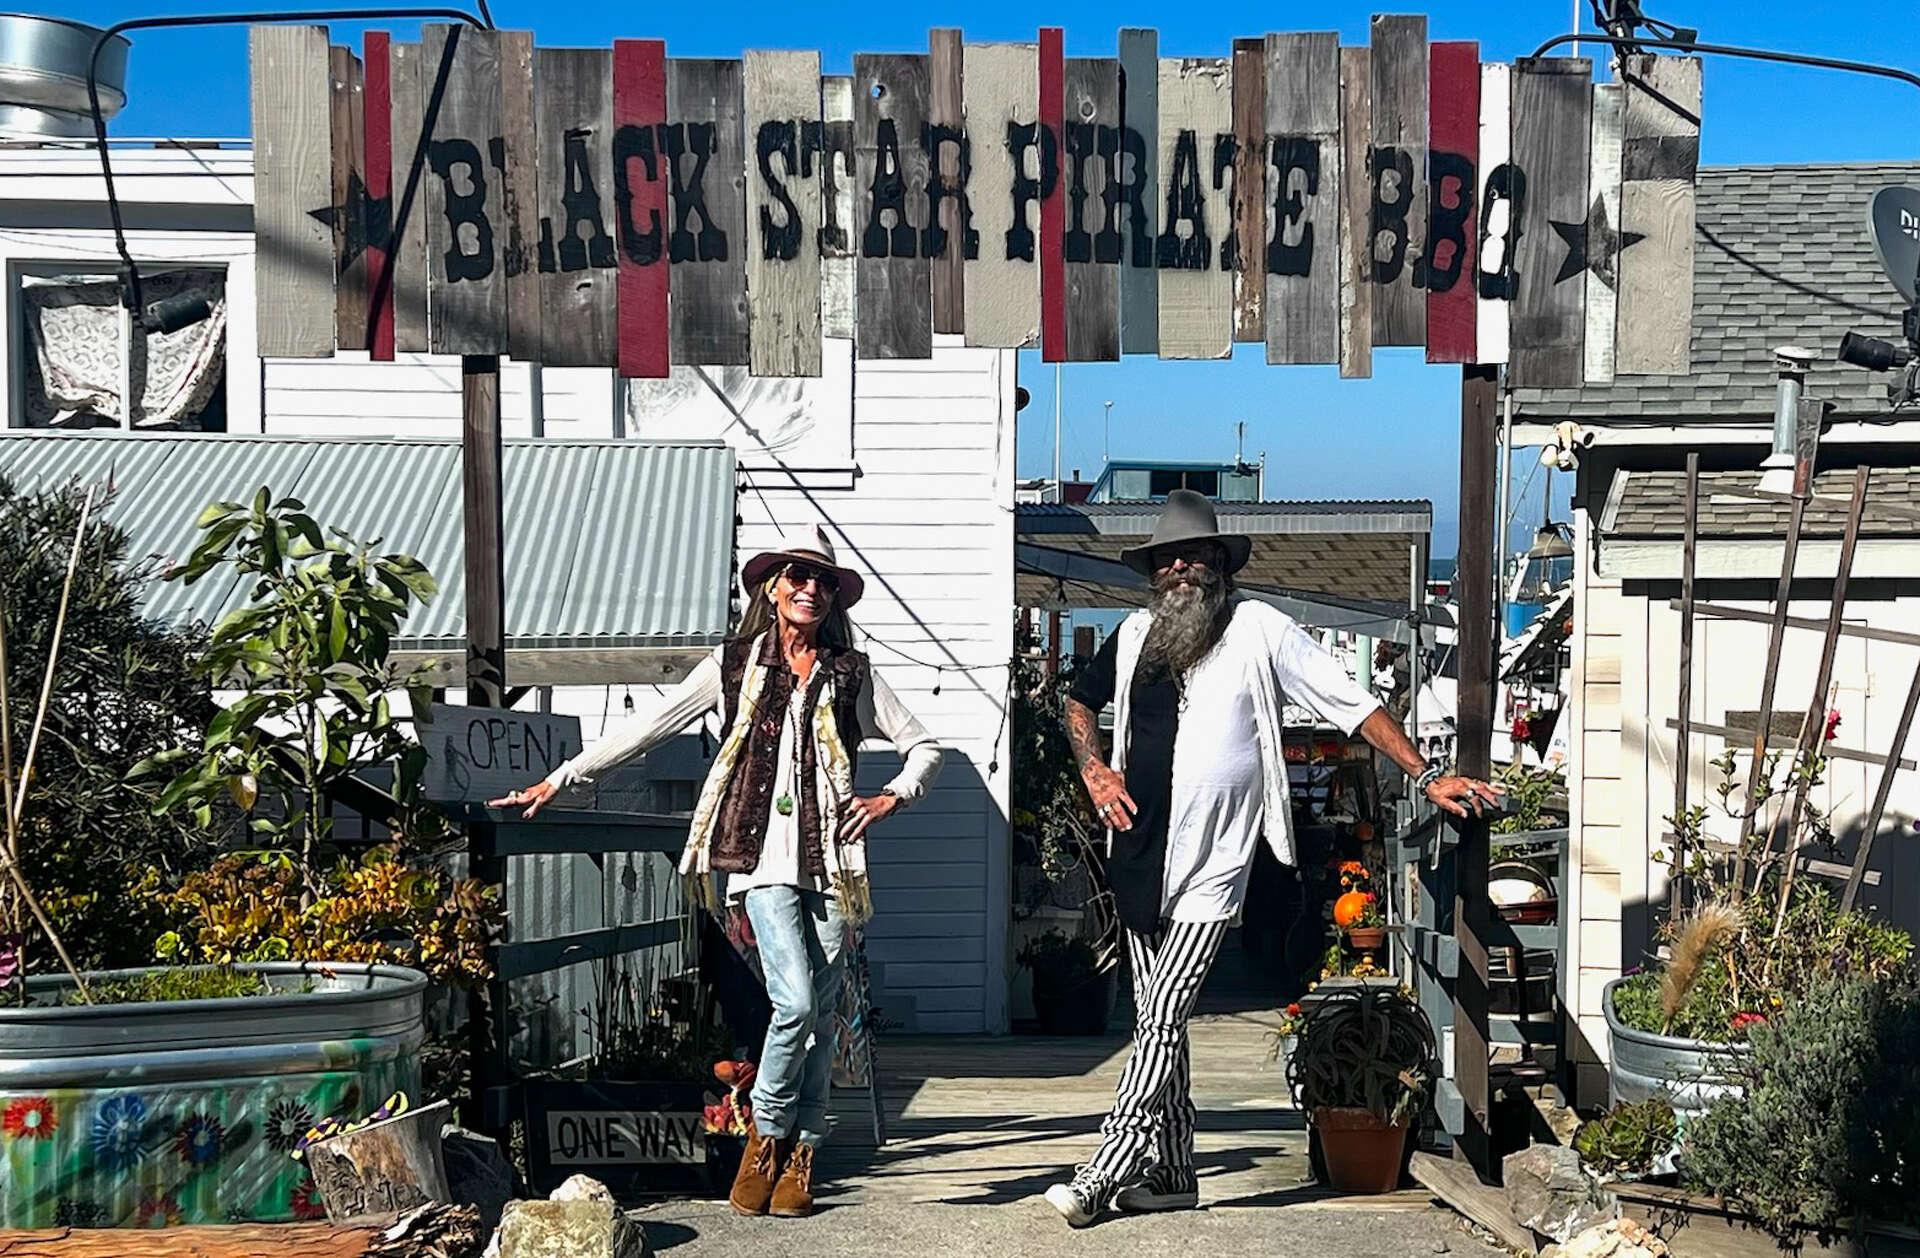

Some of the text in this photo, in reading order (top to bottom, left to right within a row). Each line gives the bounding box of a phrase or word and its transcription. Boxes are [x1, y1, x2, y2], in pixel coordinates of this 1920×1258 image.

[429, 119, 1526, 300] BLACK STAR PIRATE BBQ
[557, 1116, 699, 1159] ONE WAY
